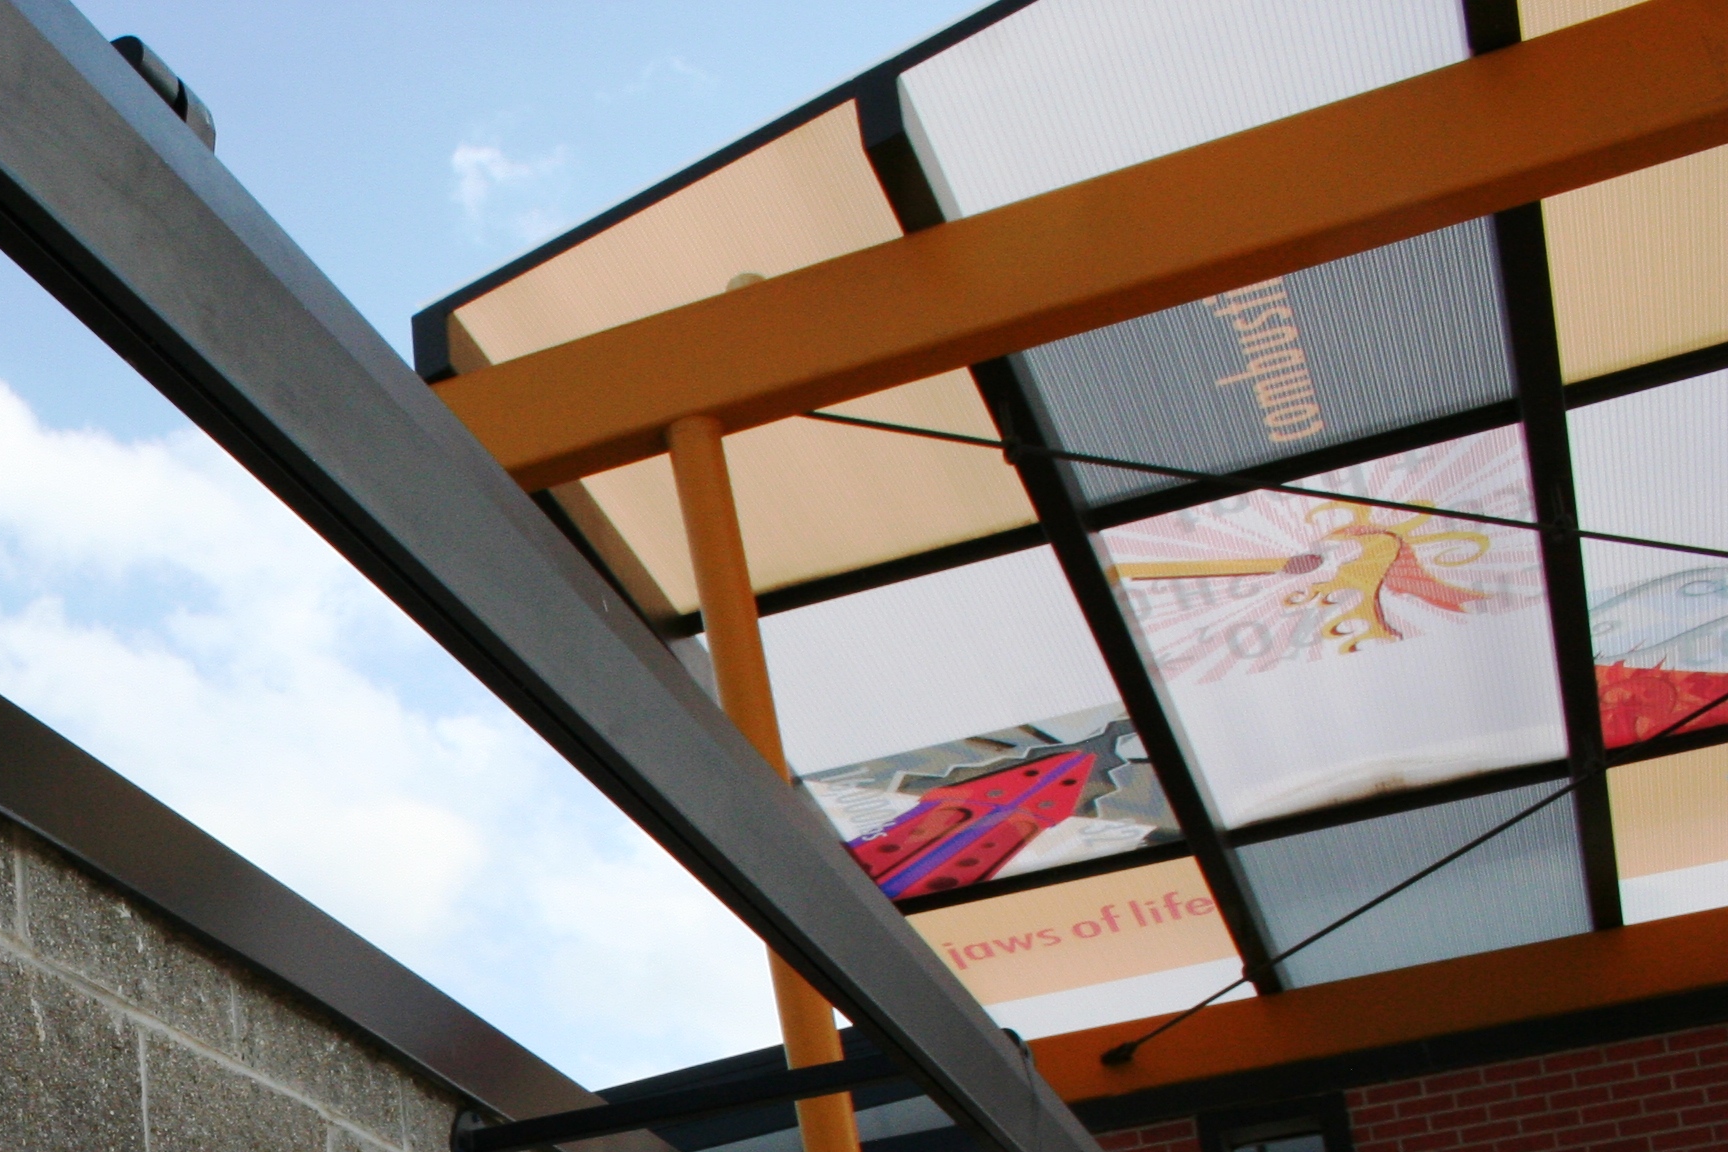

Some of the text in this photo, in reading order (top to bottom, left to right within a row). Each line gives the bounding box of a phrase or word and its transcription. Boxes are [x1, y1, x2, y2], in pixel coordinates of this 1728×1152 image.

[941, 890, 1217, 971] jaws of life
